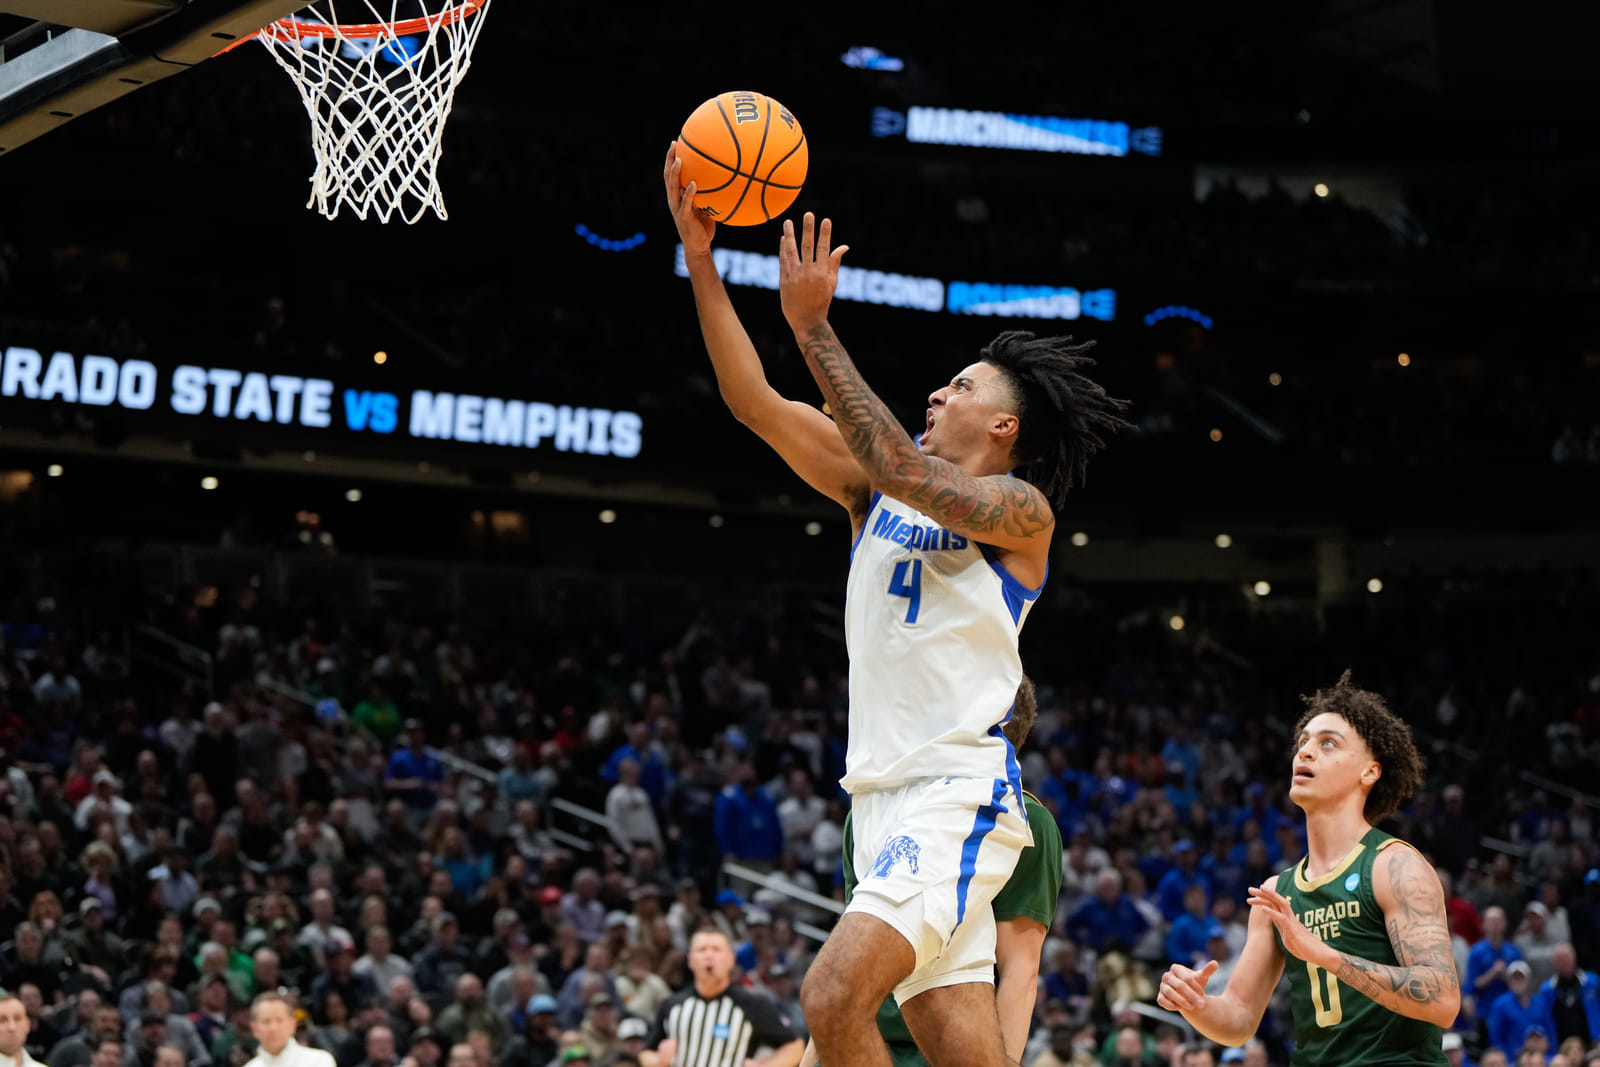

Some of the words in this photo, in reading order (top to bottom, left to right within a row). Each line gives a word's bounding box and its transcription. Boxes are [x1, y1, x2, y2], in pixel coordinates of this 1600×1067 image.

[0, 347, 158, 410] RADO
[170, 365, 334, 428] STATE
[343, 388, 399, 433] VS
[409, 390, 643, 458] MEMPHIS
[871, 507, 968, 553] Memphis
[887, 559, 922, 624] 4
[1306, 961, 1343, 1028] 0
